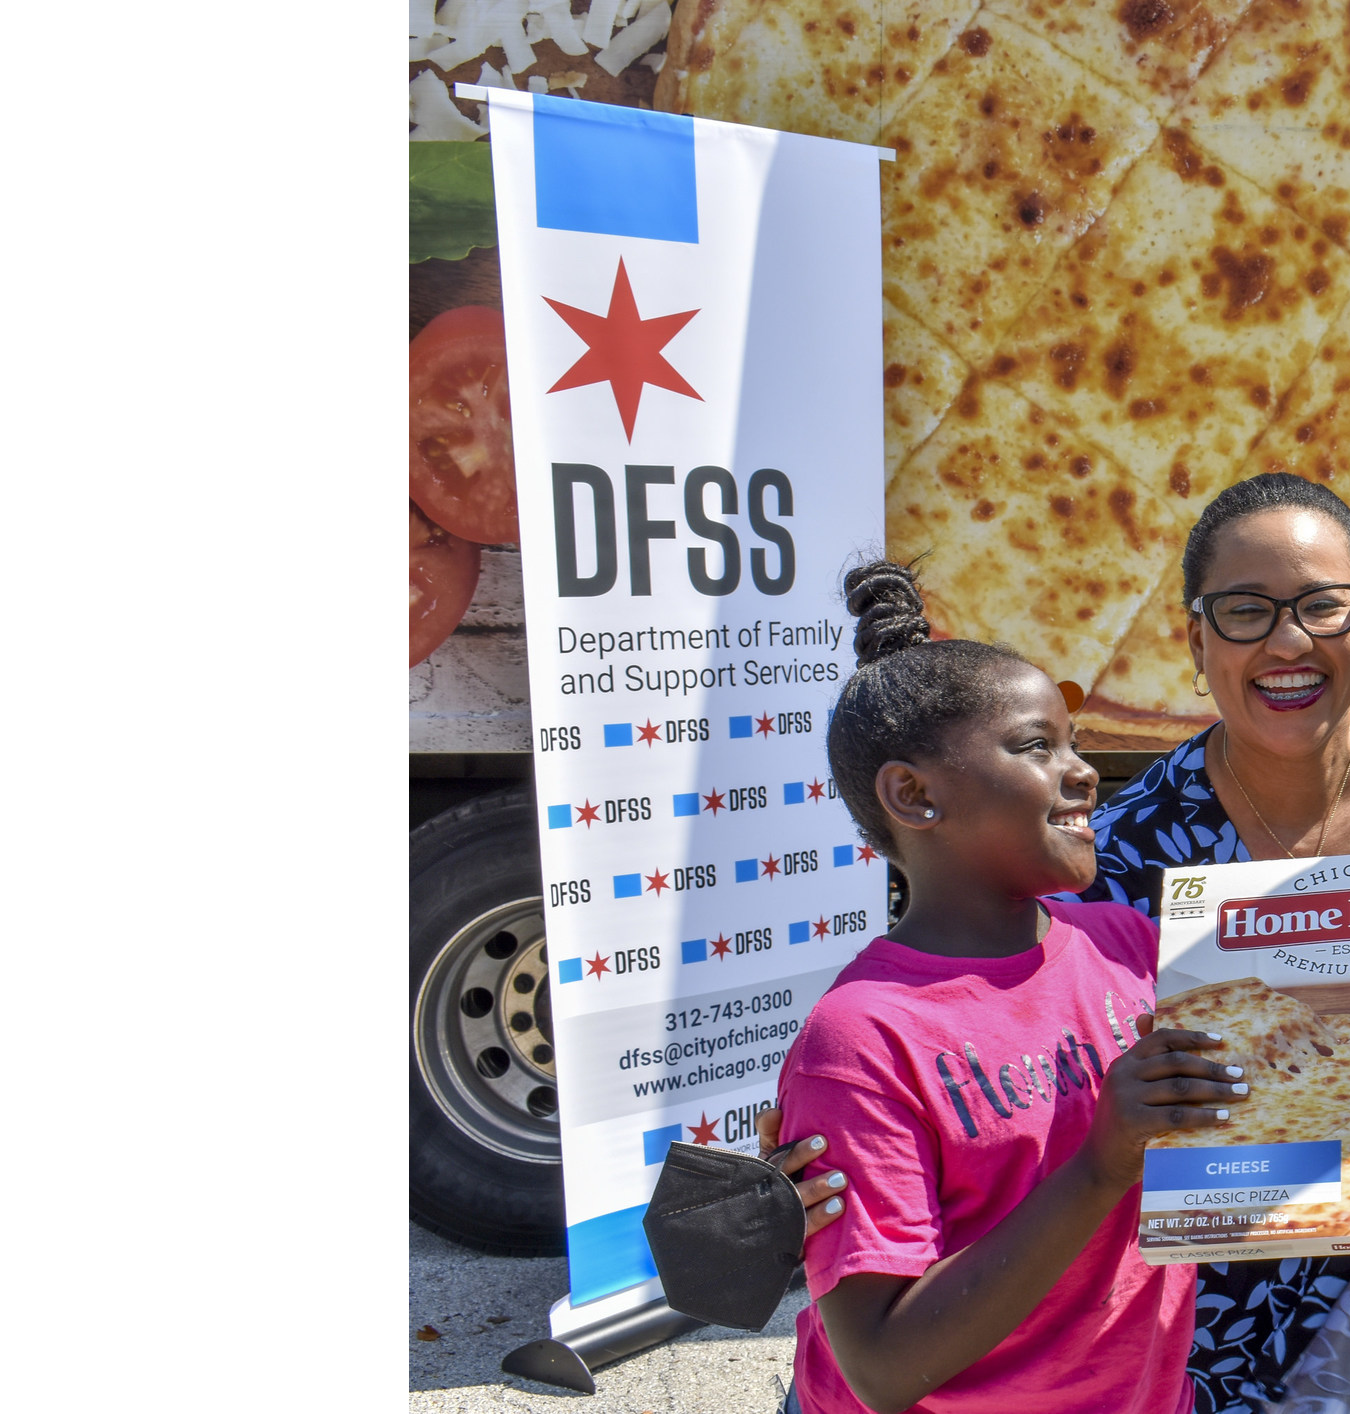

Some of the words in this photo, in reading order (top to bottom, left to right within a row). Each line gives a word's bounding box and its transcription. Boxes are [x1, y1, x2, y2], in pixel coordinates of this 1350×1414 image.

[551, 463, 796, 597] DFSS
[558, 624, 730, 660] Department
[738, 620, 762, 648] of
[768, 619, 844, 651] Family
[560, 665, 615, 695] and
[625, 663, 737, 697] Support
[744, 658, 840, 687] Services
[540, 726, 582, 752] DFSS
[666, 718, 710, 743] DFSS
[778, 711, 812, 735] DFSS
[605, 797, 651, 824] DFSS
[729, 786, 768, 811] DFSS
[550, 879, 592, 907] DFSS
[674, 864, 717, 891] DFSS
[783, 850, 819, 875] DFSS
[615, 946, 661, 976] DFSS
[735, 928, 773, 955] DFSS
[833, 910, 867, 936] DFSS
[1223, 907, 1343, 938] Home
[665, 989, 793, 1032] 312-743-0300
[619, 1017, 806, 1070] dfss@cityofchicago.
[725, 1098, 778, 1144] CHI
[1205, 1160, 1270, 1175] CHEESE
[1184, 1191, 1246, 1206] CLASSIC
[1249, 1189, 1290, 1202] PIZZA
[1148, 1219, 1165, 1229] NET
[1166, 1217, 1182, 1228] WT.
[1183, 1217, 1194, 1228] 27
[1196, 1216, 1210, 1227] OZ.
[1212, 1215, 1220, 1228] (1
[1222, 1215, 1236, 1226] LB.
[1238, 1214, 1247, 1224] 11
[1250, 1213, 1266, 1226] OZ.)
[1268, 1213, 1289, 1225] 765g
[1170, 1250, 1225, 1259] CLASSIC
[1228, 1247, 1265, 1256] PIZZA
